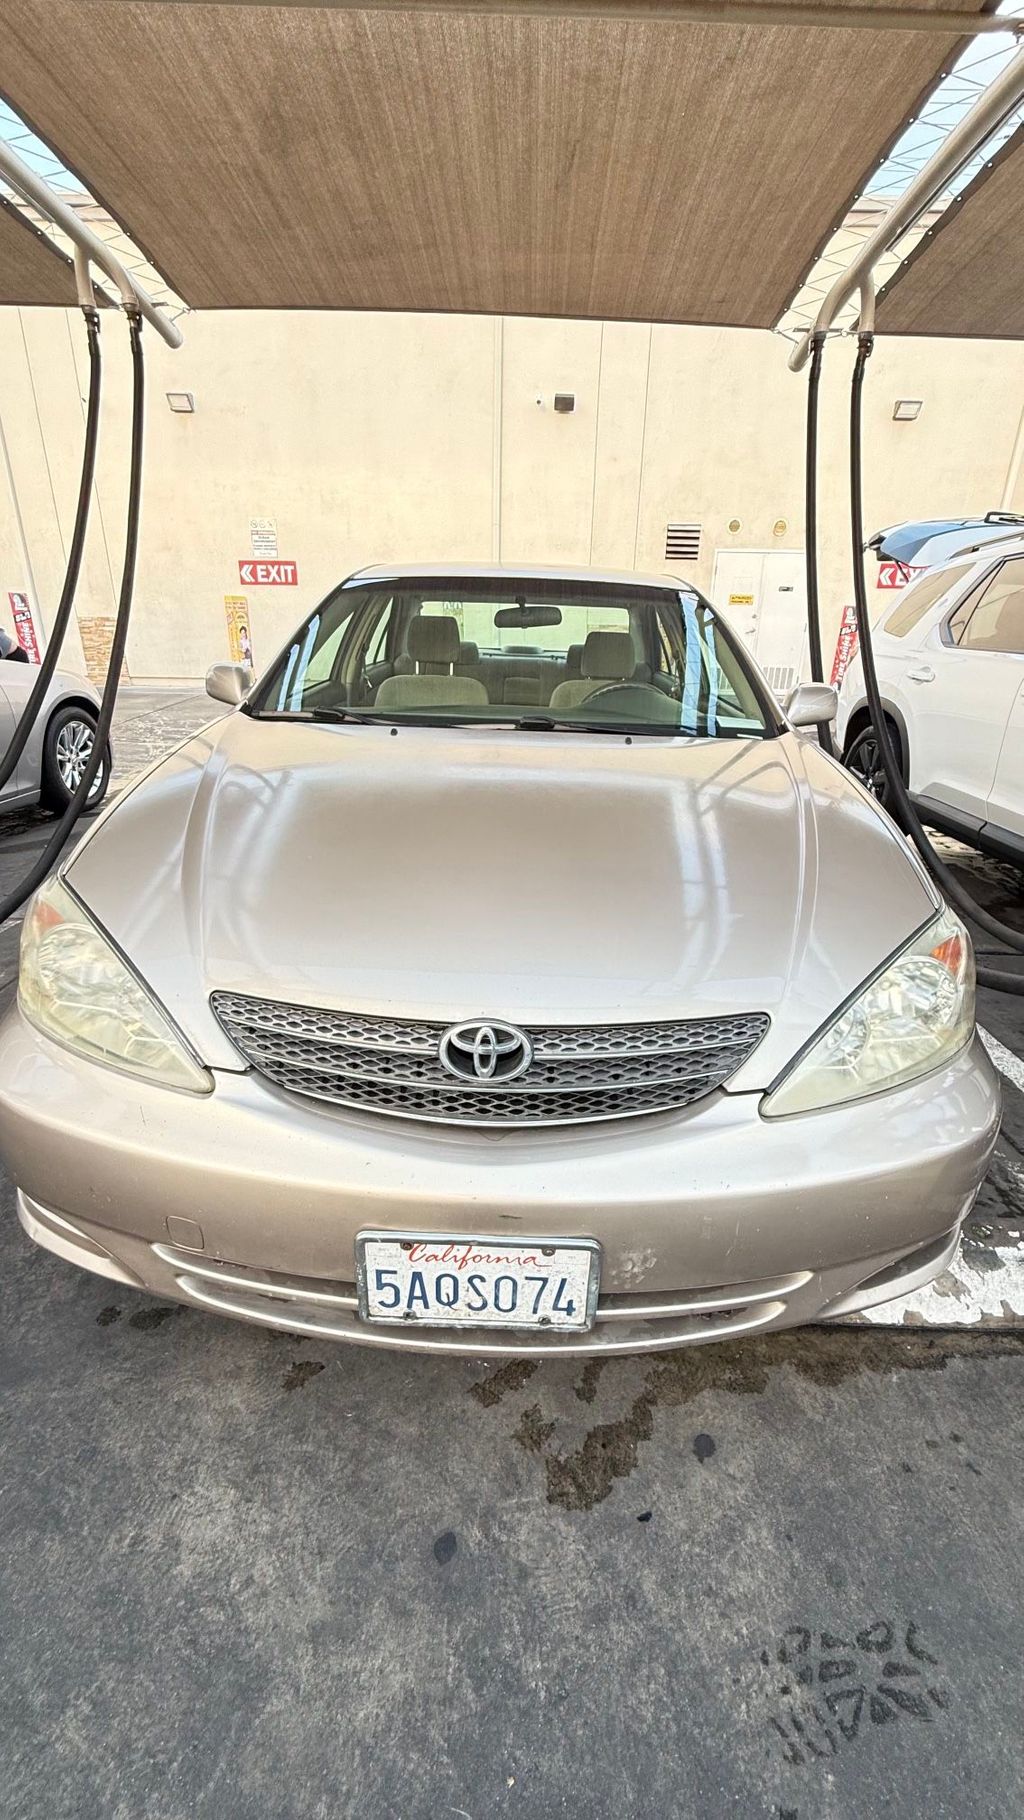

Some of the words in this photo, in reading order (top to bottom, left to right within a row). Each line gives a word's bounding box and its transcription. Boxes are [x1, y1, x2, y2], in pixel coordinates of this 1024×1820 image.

[256, 564, 295, 583] EXIT
[23, 622, 33, 648] SHINE
[840, 635, 851, 662] SHINE
[408, 1243, 553, 1270] California
[375, 1269, 577, 1316] 5AQS074
